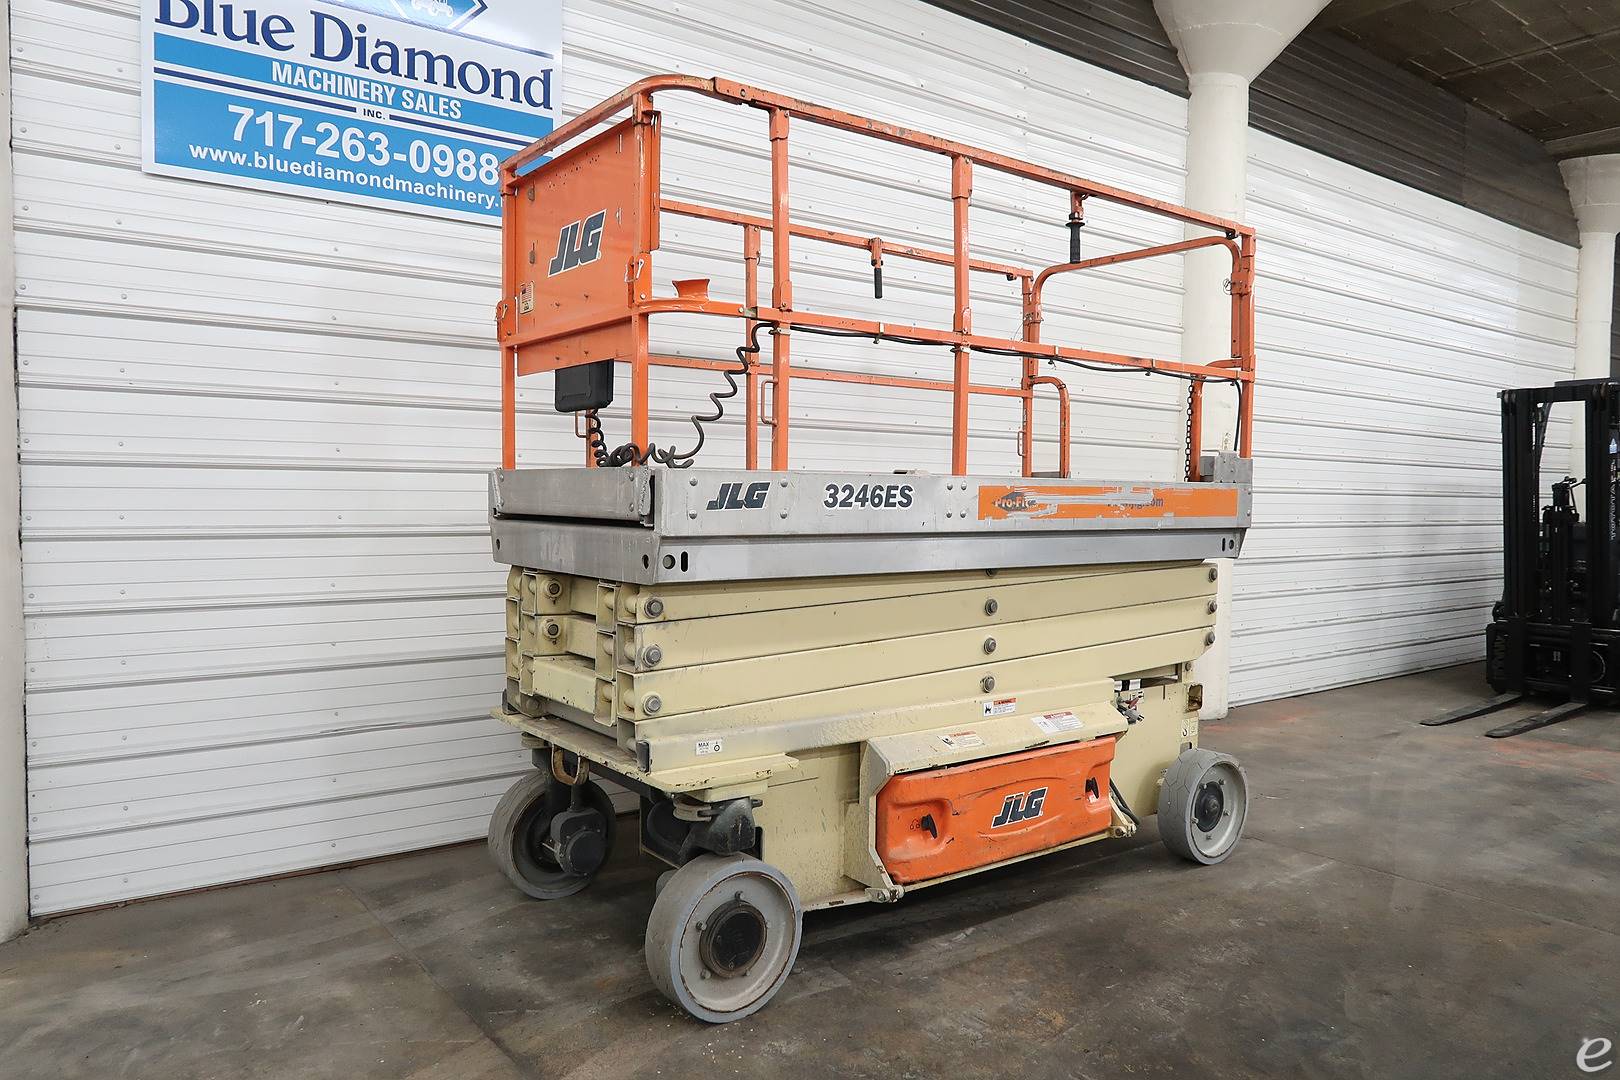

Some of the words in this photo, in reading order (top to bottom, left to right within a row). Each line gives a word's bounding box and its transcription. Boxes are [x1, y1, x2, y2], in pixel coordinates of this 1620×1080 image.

[310, 10, 553, 110] Diamond
[272, 61, 396, 106] MACHINERY
[401, 89, 462, 119] SALES
[362, 108, 386, 120] INC.
[227, 104, 499, 185] 717-263-0988
[188, 144, 503, 209] www.bluediamondmachinery.
[547, 209, 607, 277] JLG
[705, 481, 771, 511] JLG
[823, 483, 914, 509] 3246ES
[991, 787, 1048, 828] JLG
